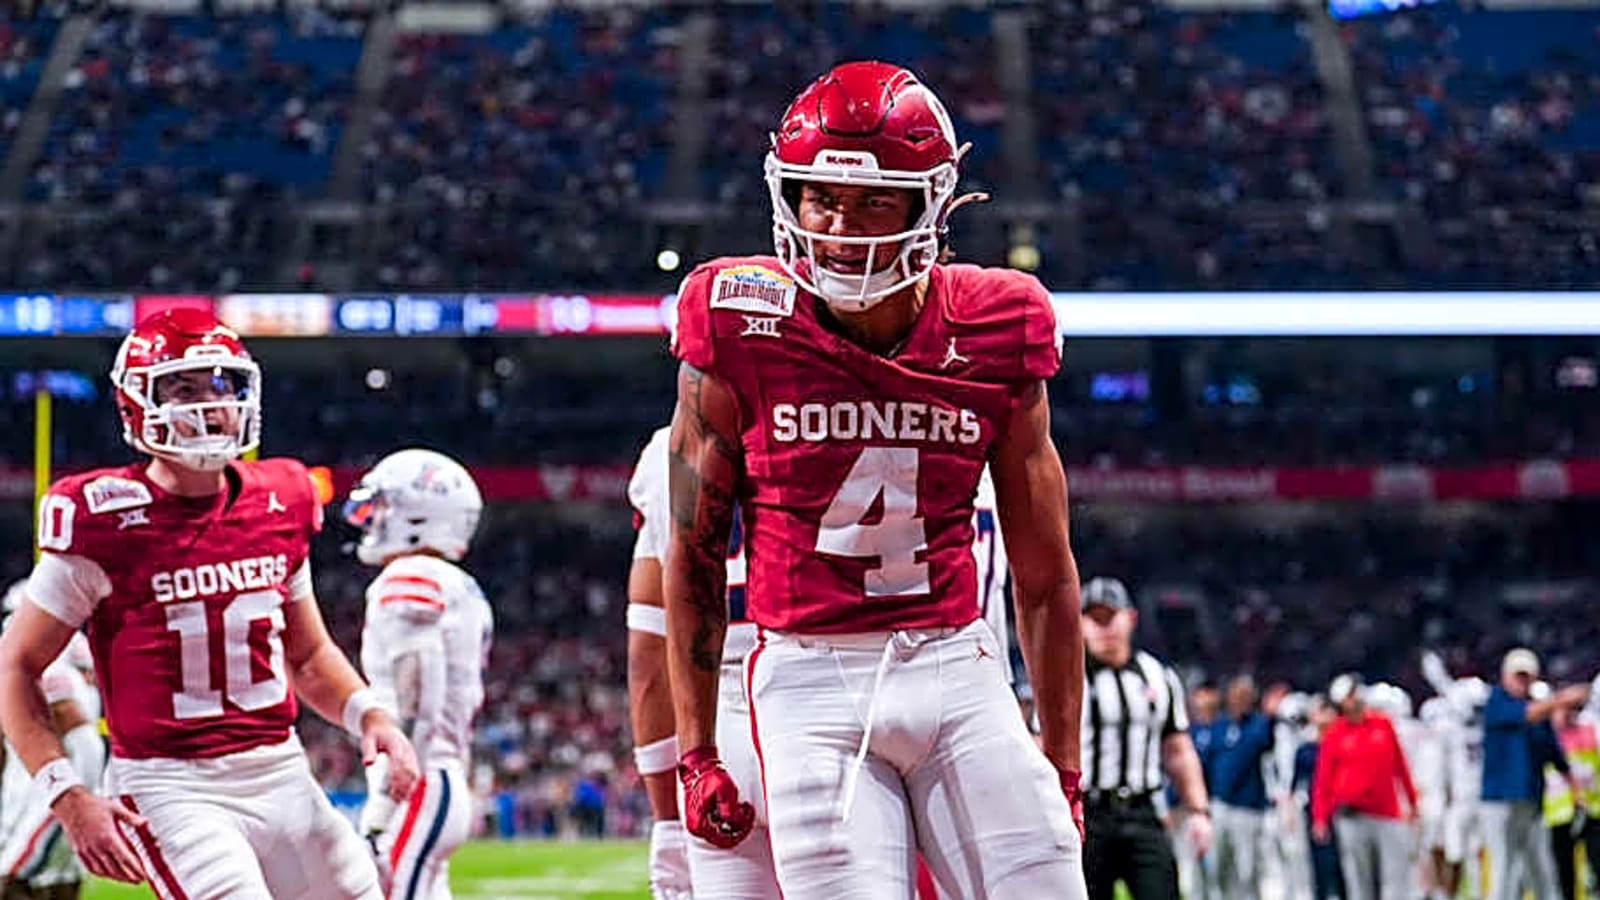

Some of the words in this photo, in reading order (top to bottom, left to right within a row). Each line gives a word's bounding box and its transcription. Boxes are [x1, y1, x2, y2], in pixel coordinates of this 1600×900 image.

[772, 401, 982, 444] SOONERS
[814, 446, 932, 597] 4
[151, 554, 288, 602] SOONERS
[164, 589, 289, 720] 10
